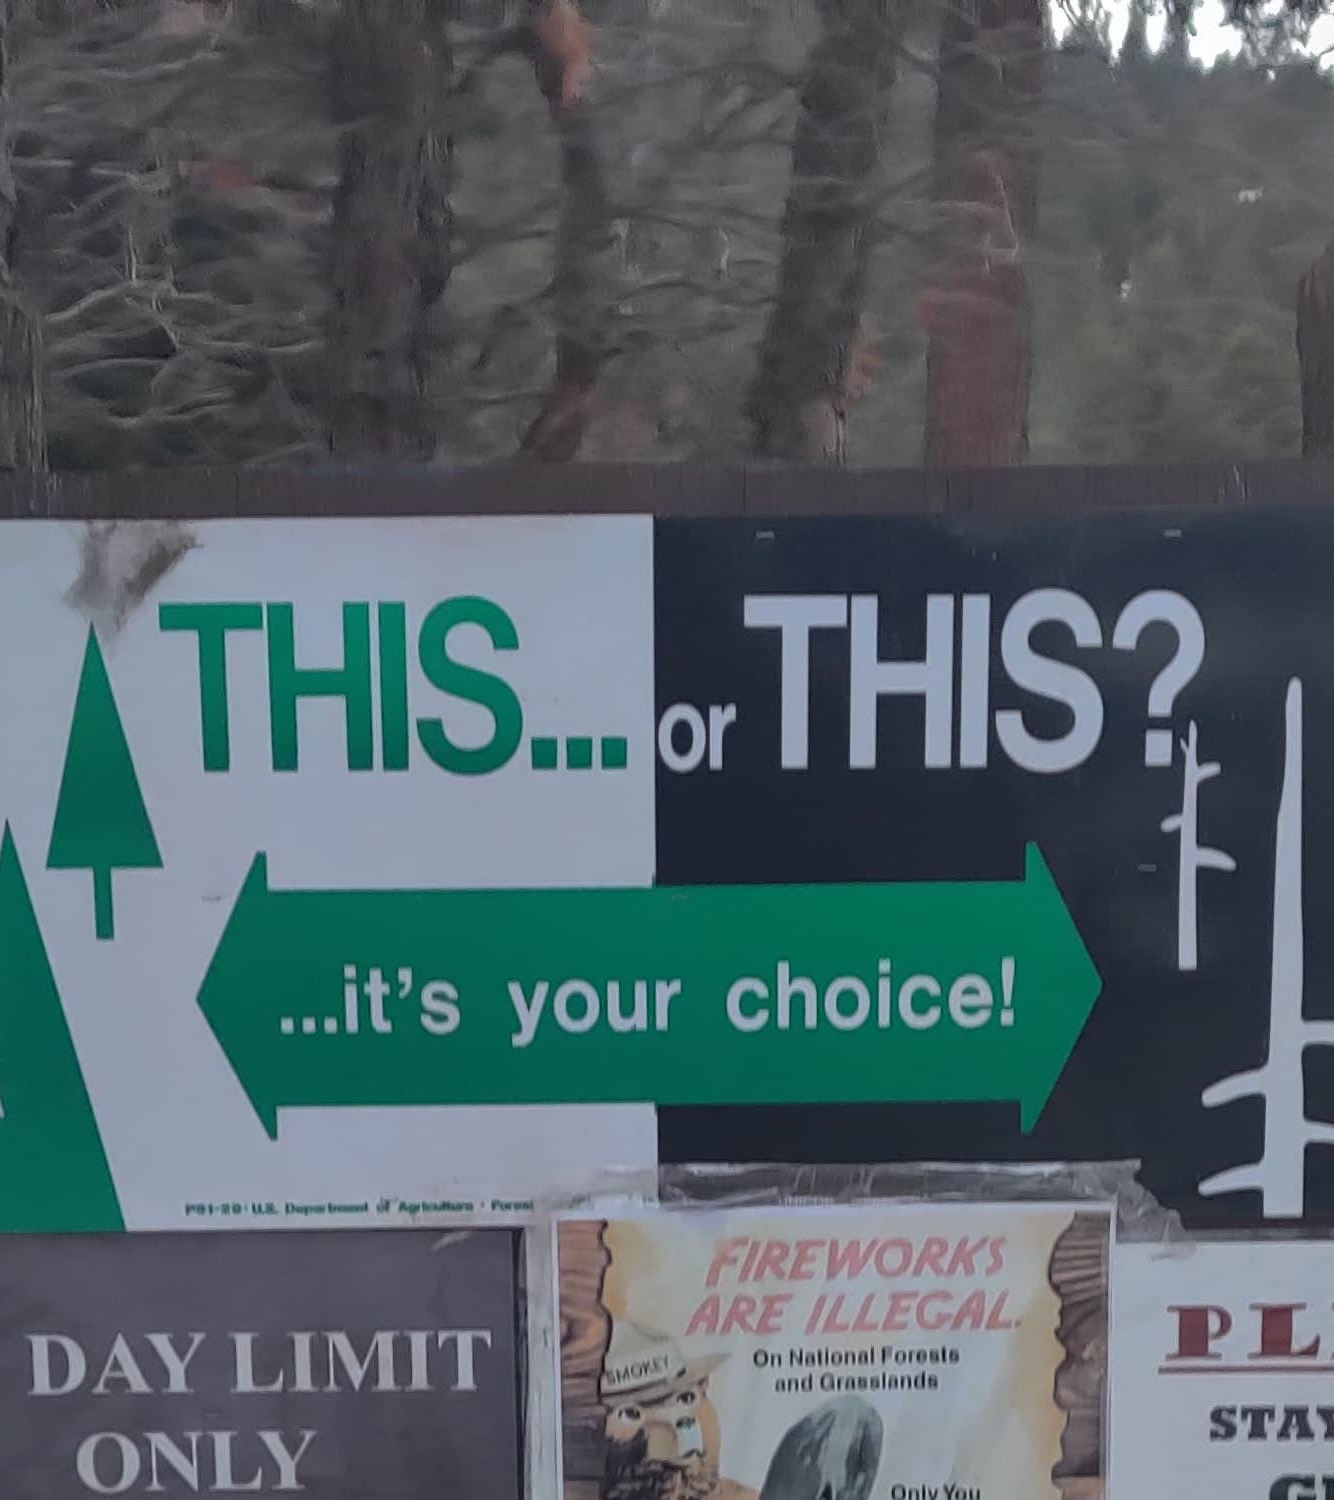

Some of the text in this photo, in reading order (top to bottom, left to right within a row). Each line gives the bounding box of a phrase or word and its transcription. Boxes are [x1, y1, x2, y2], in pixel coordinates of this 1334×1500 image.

[158, 588, 1206, 776] THIS... or THIS?
[508, 975, 682, 1048] your
[725, 957, 1017, 1032] choice!
[285, 1201, 368, 1216] Department
[376, 1199, 391, 1212] of
[398, 1199, 474, 1214] Agriculture
[705, 1235, 1007, 1287] FIREWORKS
[685, 1290, 1022, 1336] ARE ILLEGAL.
[27, 1333, 206, 1396] DAY
[231, 1330, 493, 1393] LIMIT
[752, 1345, 960, 1368] On National Forests
[774, 1370, 939, 1392] and Grasslands
[75, 1431, 319, 1494] ONLY
